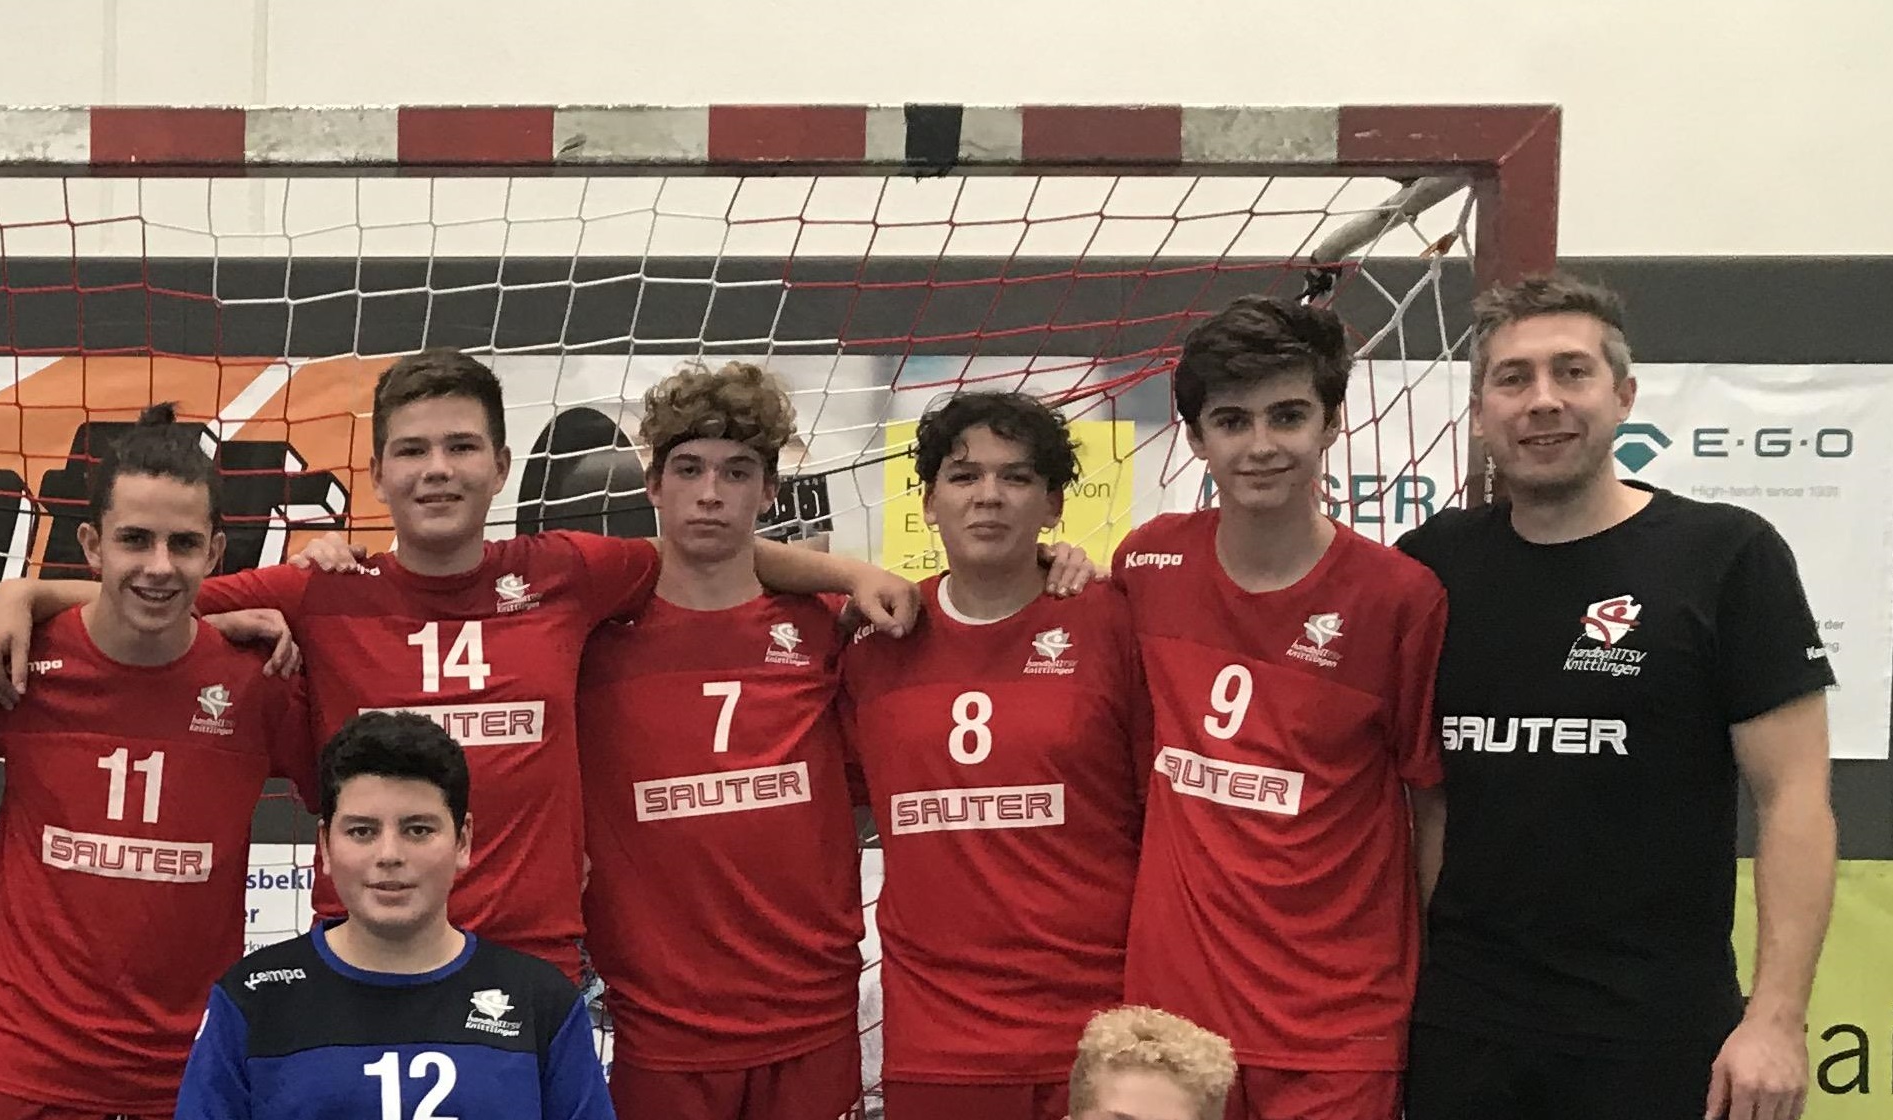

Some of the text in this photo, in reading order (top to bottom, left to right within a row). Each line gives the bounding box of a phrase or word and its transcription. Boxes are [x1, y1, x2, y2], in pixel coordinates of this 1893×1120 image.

[1124, 551, 1184, 569] Kempa
[408, 621, 491, 693] 14
[1563, 658, 1641, 677] Knittlingen
[702, 681, 742, 753] 7
[1204, 664, 1253, 740] 9
[948, 692, 993, 765] 8
[1441, 718, 1629, 755] SAUTER
[97, 748, 166, 824] 11
[644, 770, 804, 812] SAUTER
[896, 791, 1052, 826] SAUTER
[50, 835, 203, 876] SAUTER
